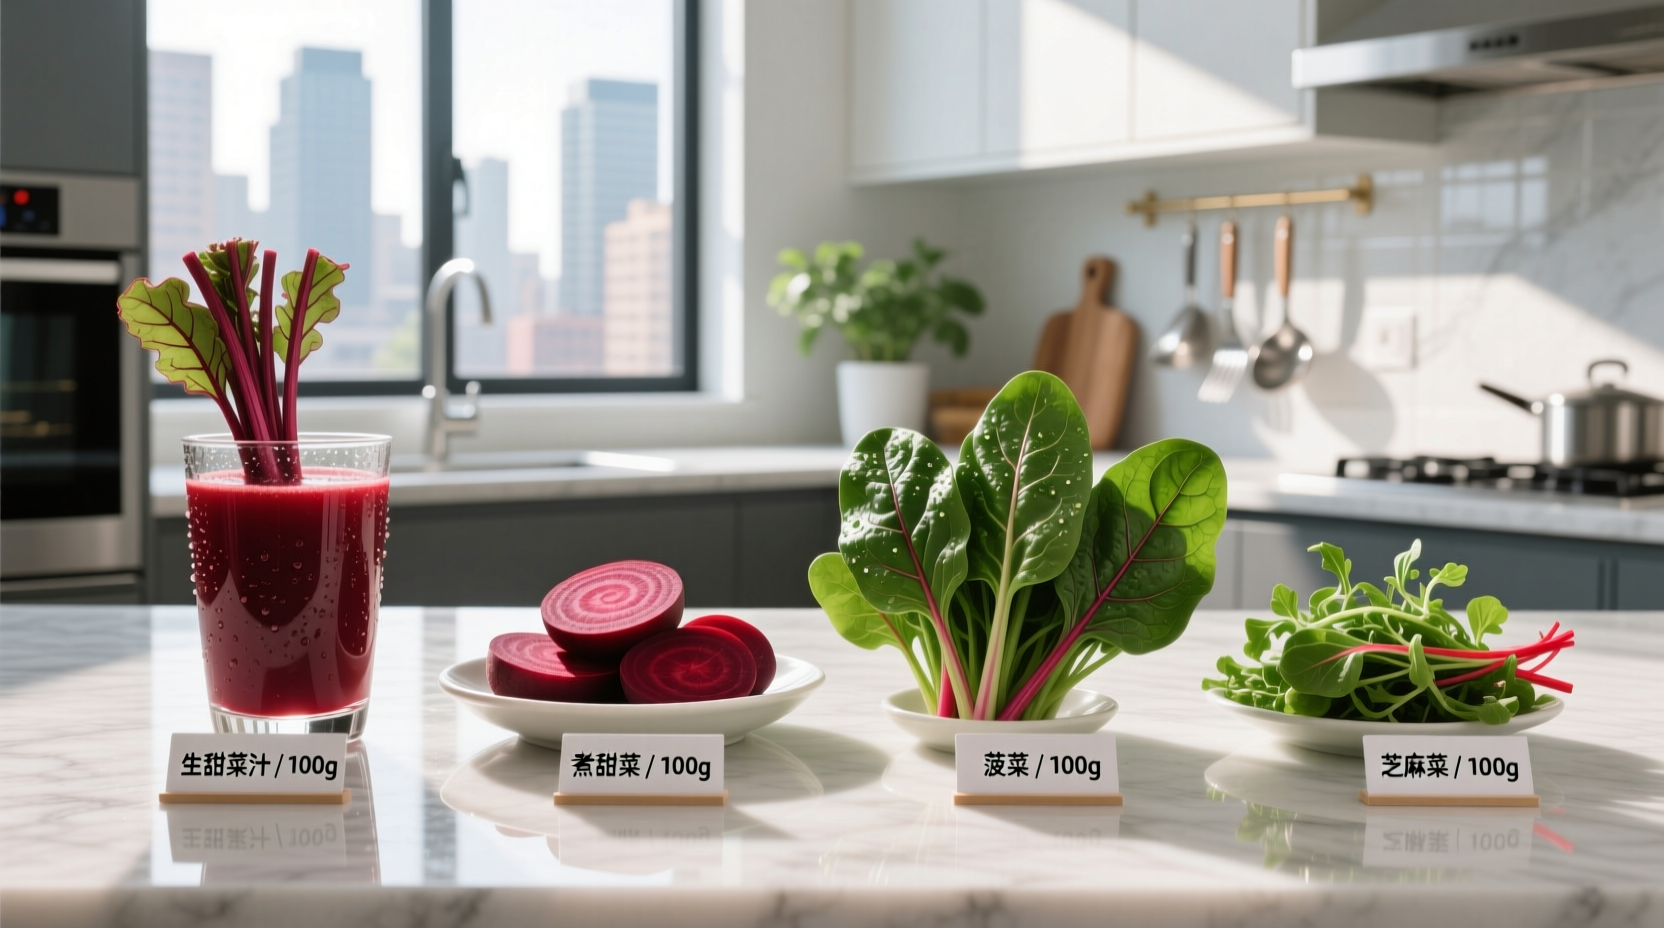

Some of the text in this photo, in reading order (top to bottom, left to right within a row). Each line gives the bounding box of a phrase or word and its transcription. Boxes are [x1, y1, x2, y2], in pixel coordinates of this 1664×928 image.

[180, 751, 338, 781] 生甜菜汁 / 100g
[570, 751, 711, 782] 煮甜菜 / 100g
[983, 751, 1101, 781] 菠菜 / 100g
[1380, 751, 1519, 783] 芝麻菜 / 100g
